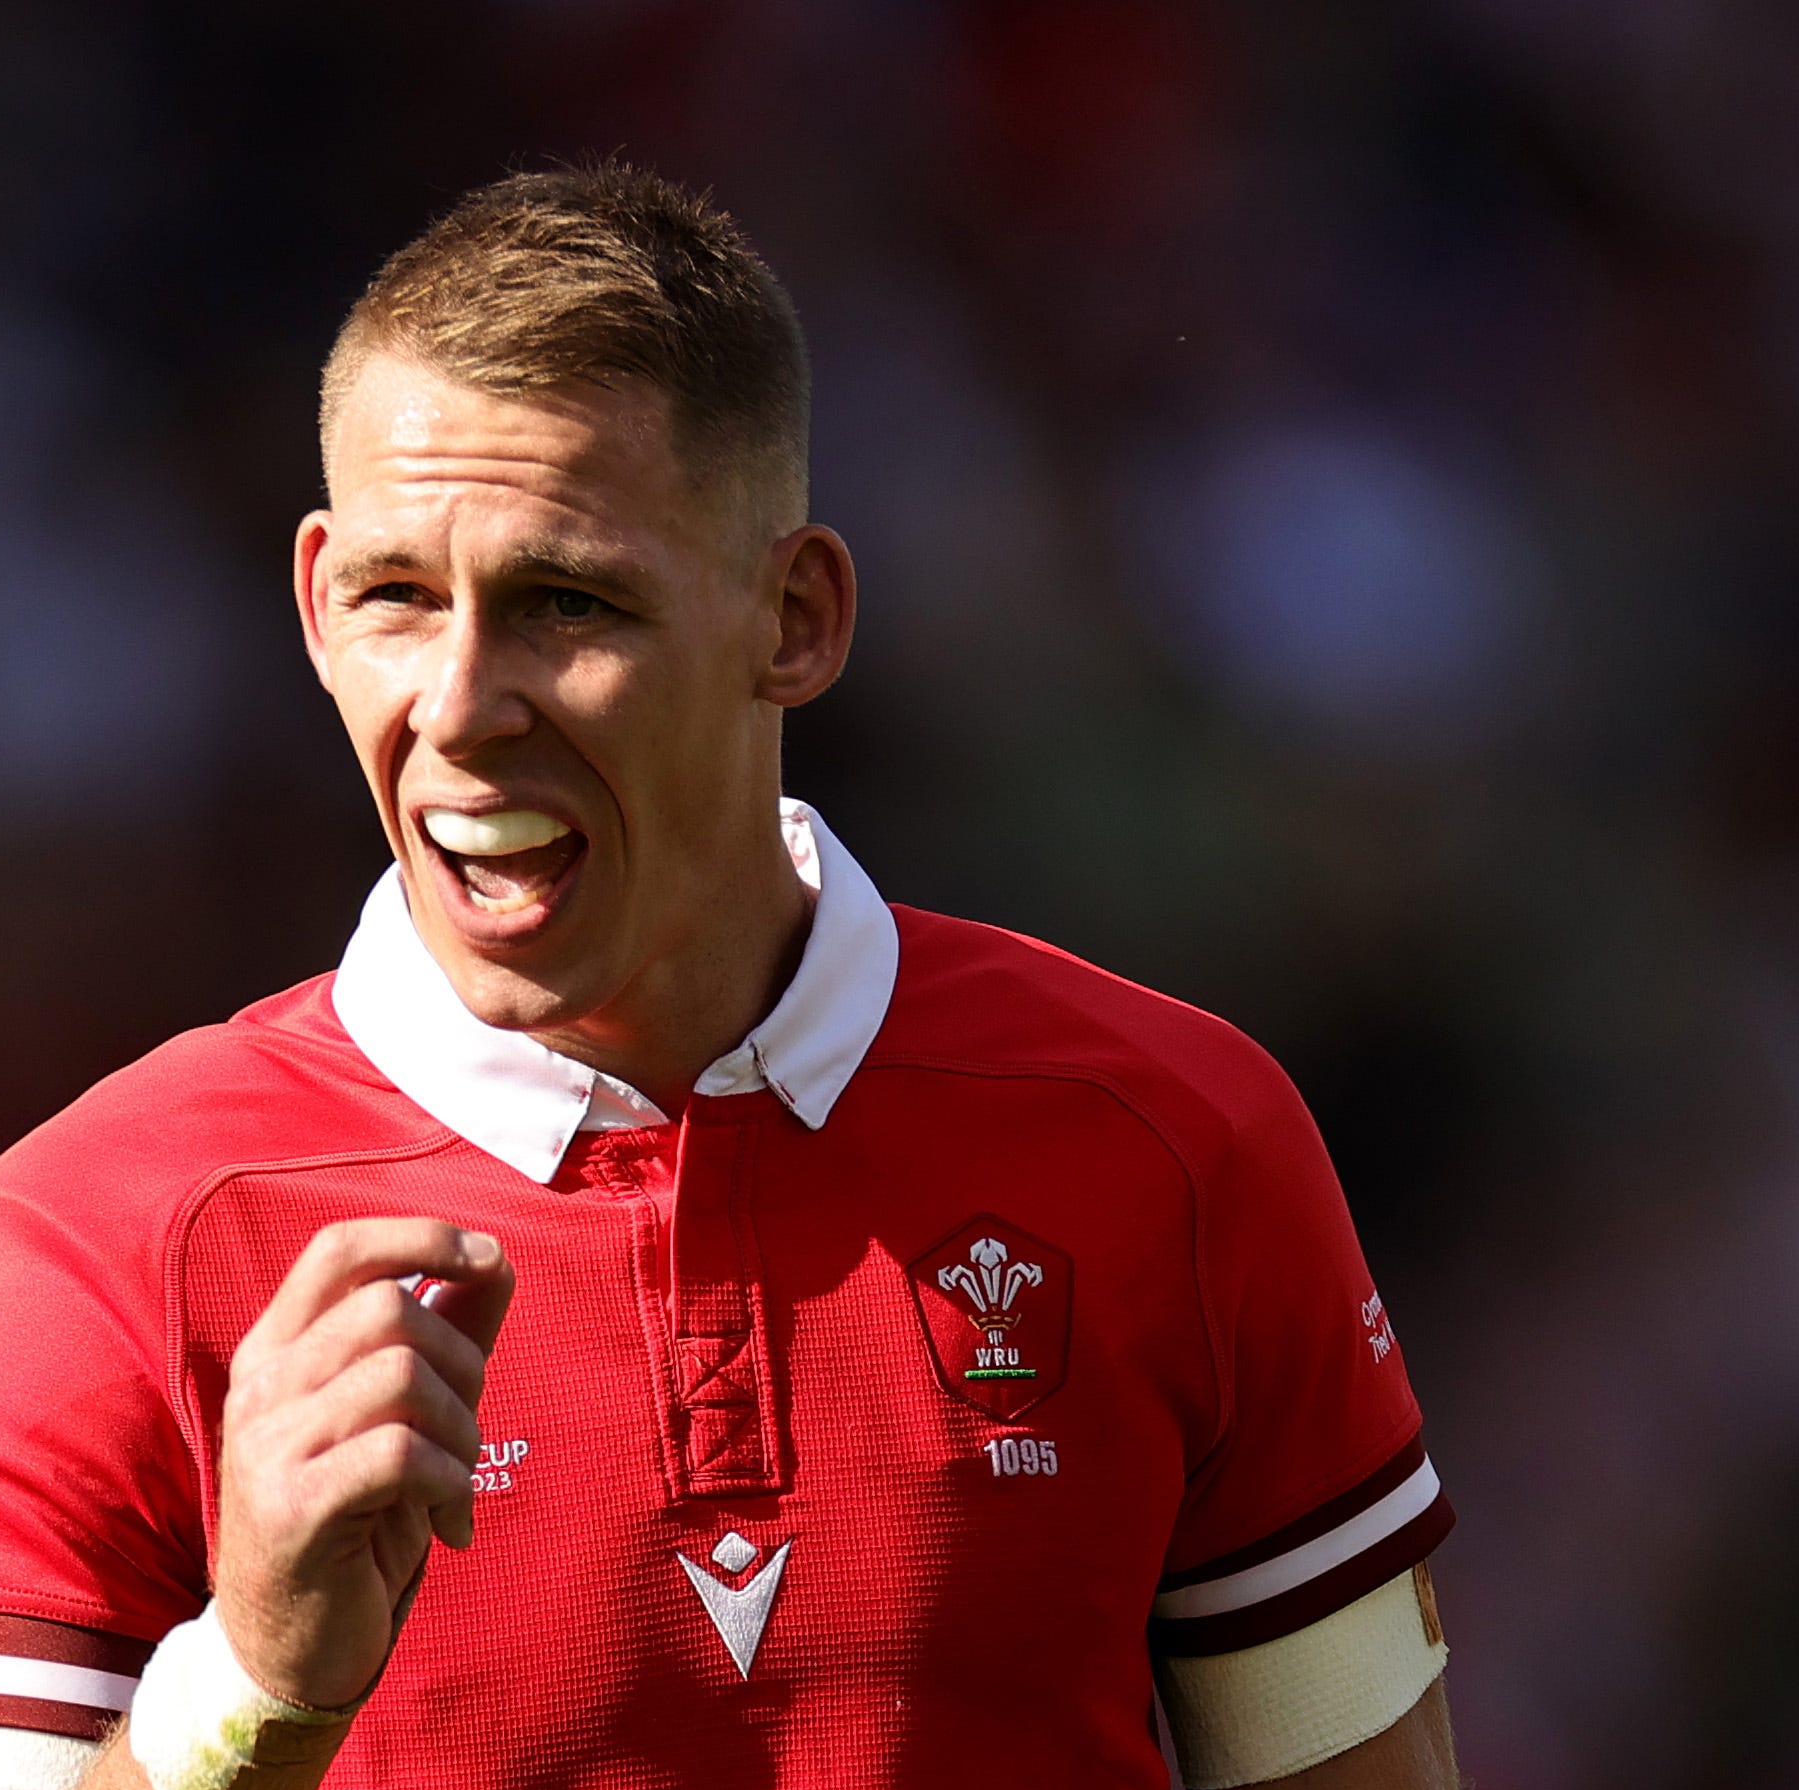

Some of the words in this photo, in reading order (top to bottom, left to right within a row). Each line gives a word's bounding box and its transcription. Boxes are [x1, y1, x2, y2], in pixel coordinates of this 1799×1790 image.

[975, 1347, 1020, 1368] WRU
[983, 1438, 1059, 1477] 1095
[469, 1470, 513, 1492] 023
